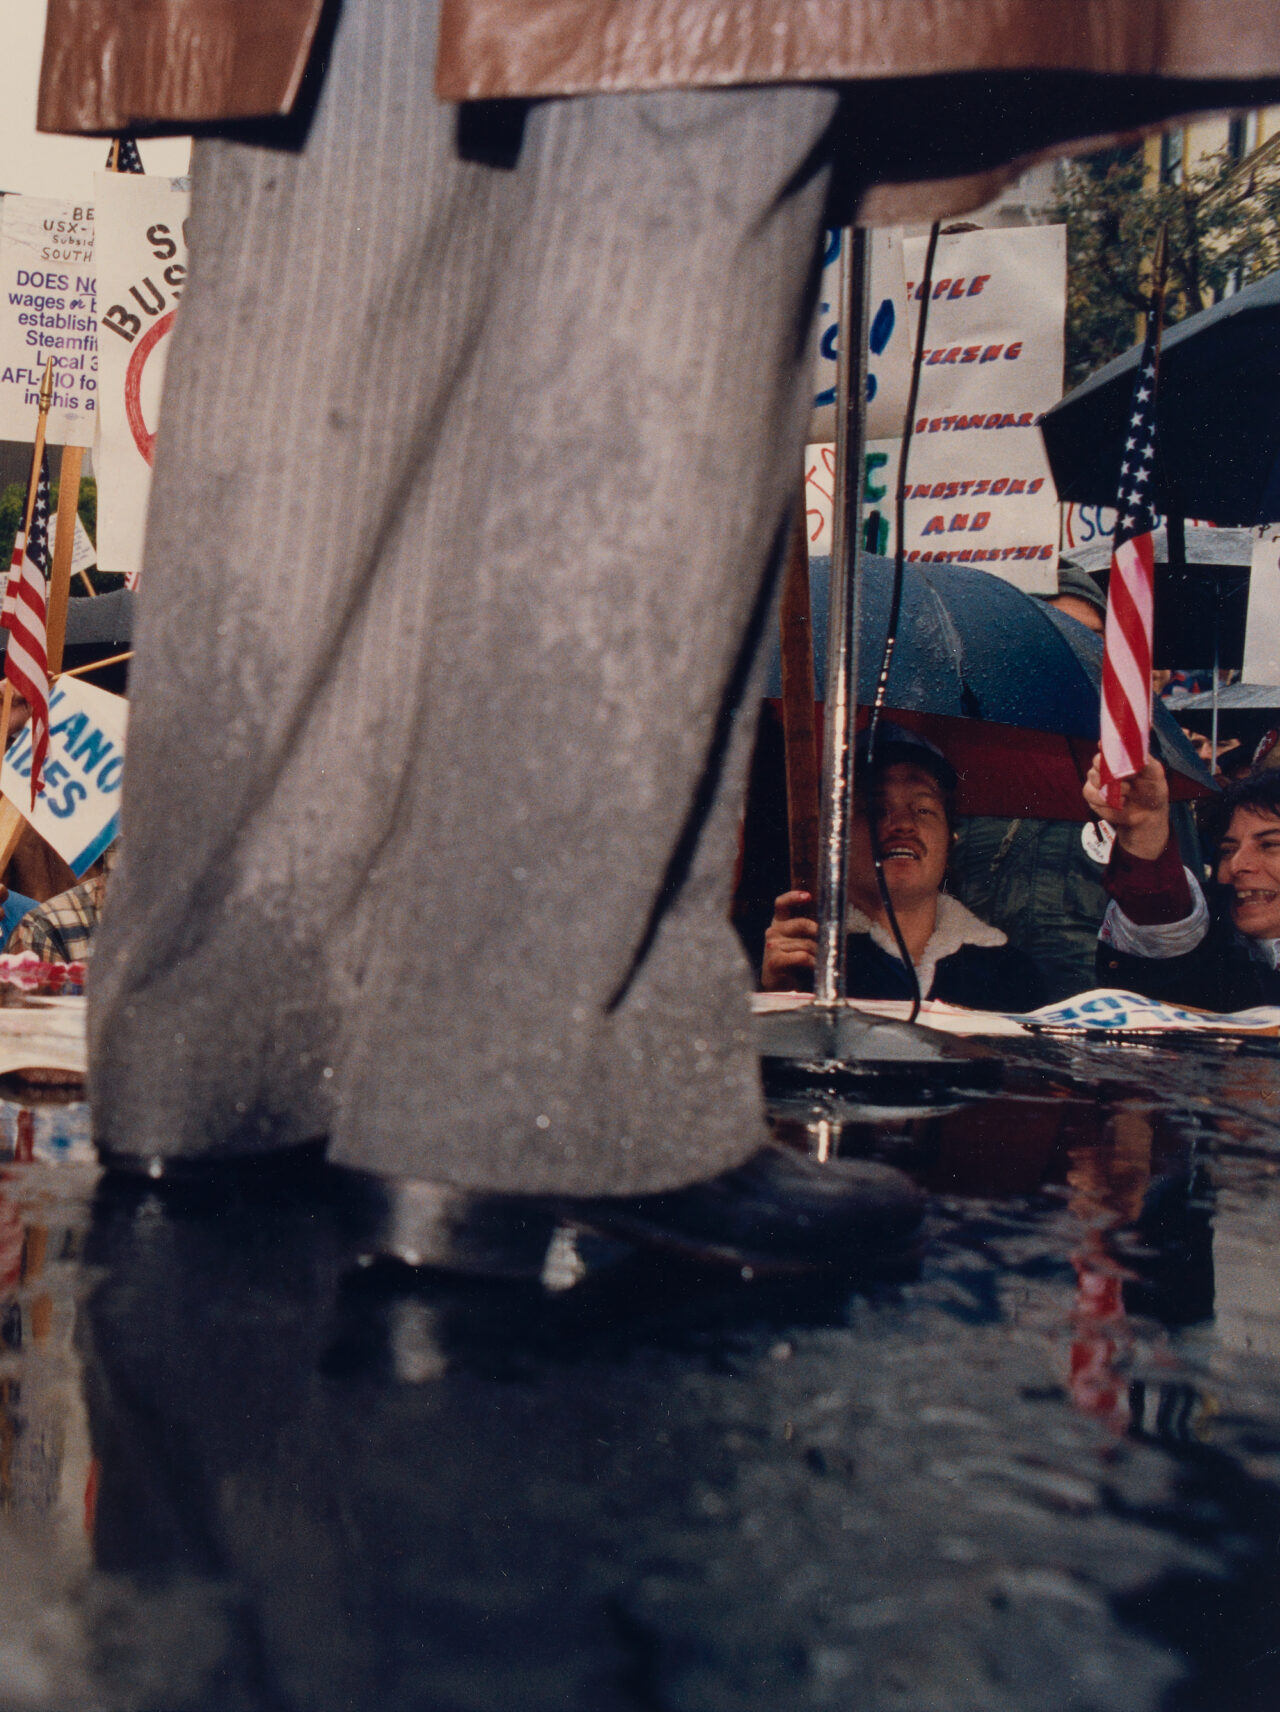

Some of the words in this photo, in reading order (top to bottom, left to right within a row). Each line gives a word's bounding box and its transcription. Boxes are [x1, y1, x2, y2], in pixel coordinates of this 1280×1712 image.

[16, 270, 70, 291] DOES
[8, 292, 65, 312] wages
[18, 312, 97, 333] establish
[36, 350, 85, 370] Local
[1, 366, 75, 389] AFL-IO
[24, 388, 40, 405] in
[50, 391, 79, 409] his
[921, 511, 991, 537] AND
